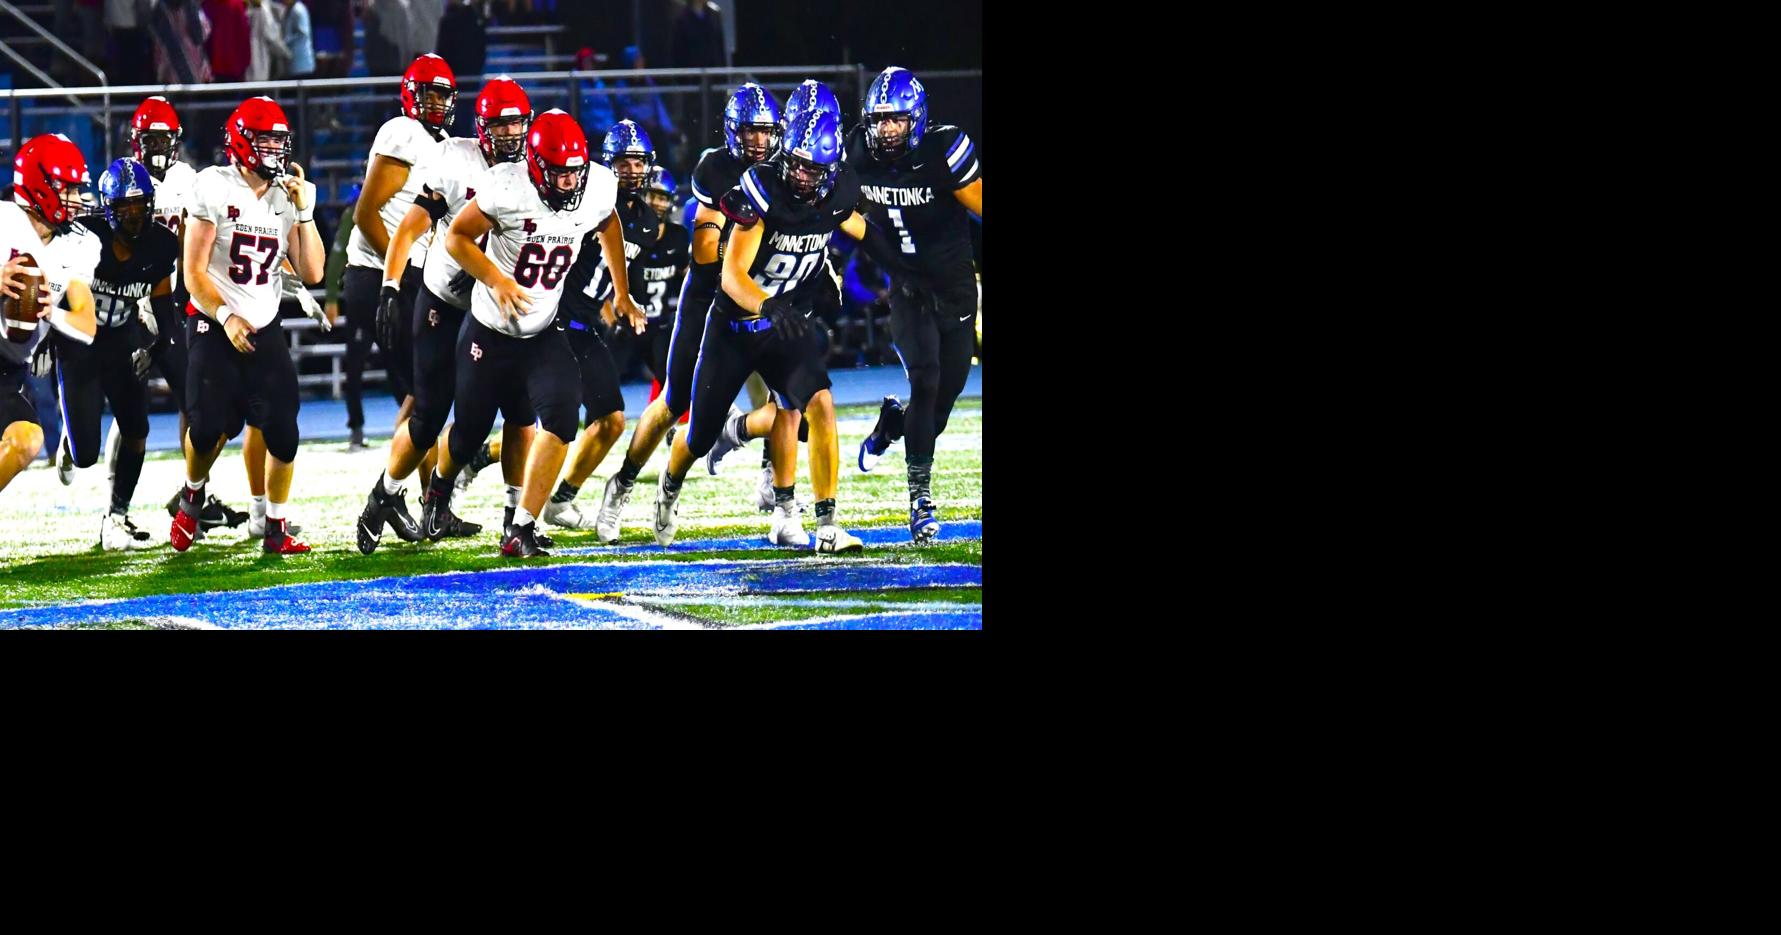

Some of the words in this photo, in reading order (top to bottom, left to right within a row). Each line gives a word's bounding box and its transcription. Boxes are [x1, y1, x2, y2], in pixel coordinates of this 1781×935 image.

[235, 223, 253, 233] EDEN
[254, 226, 278, 236] PRAIRIE
[887, 208, 916, 253] 1
[228, 231, 279, 286] 57
[645, 281, 667, 317] 3
